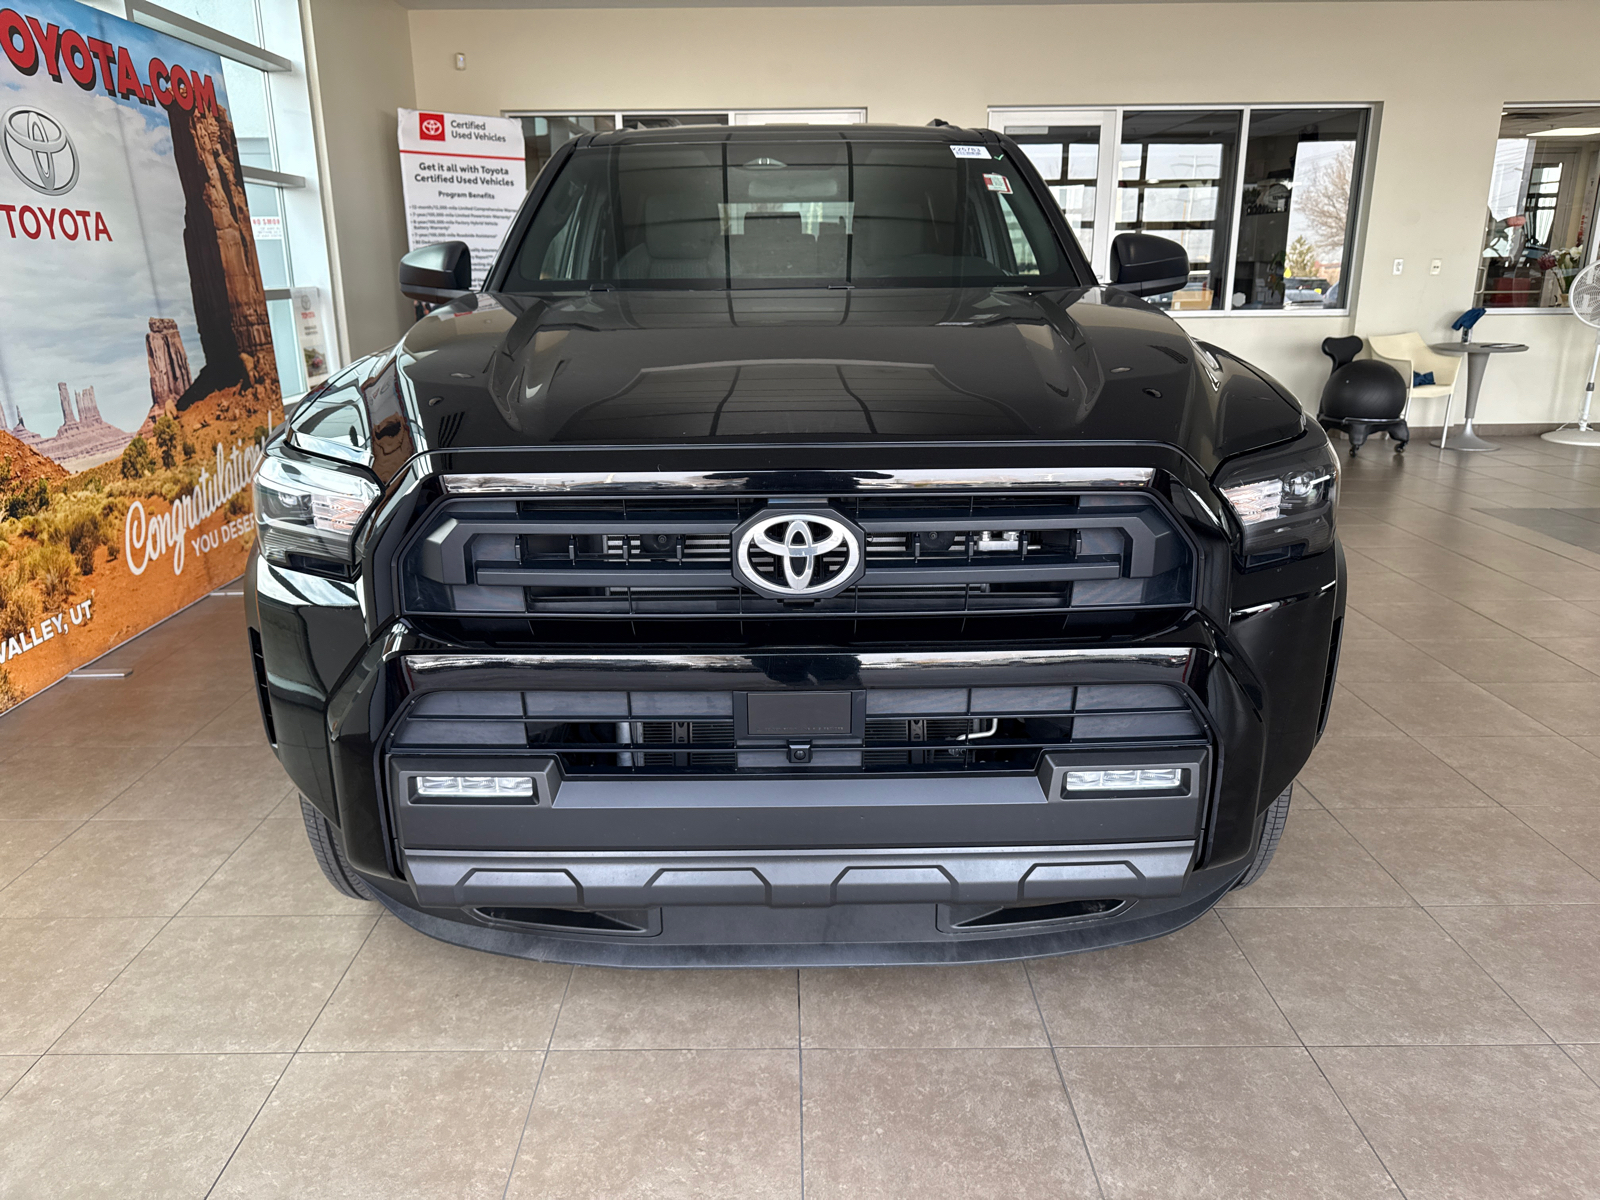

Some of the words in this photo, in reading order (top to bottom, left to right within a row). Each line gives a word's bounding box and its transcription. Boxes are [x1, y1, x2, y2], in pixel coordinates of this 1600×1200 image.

[451, 120, 486, 131] Certified
[451, 131, 472, 140] Used
[474, 132, 506, 143] Vehicles
[419, 162, 436, 172] Get
[437, 163, 444, 172] it
[446, 164, 458, 173] all
[460, 164, 479, 174] with
[481, 166, 509, 176] Toyota
[415, 174, 454, 184] Certified
[456, 176, 478, 185] Used
[480, 177, 515, 187] Vehicles
[438, 190, 467, 199] Program
[468, 191, 495, 200] Benefits
[0, 204, 113, 242] TOYOTA
[125, 434, 265, 575] Congratulation
[191, 529, 219, 557] YOU
[69, 599, 92, 626] UT
